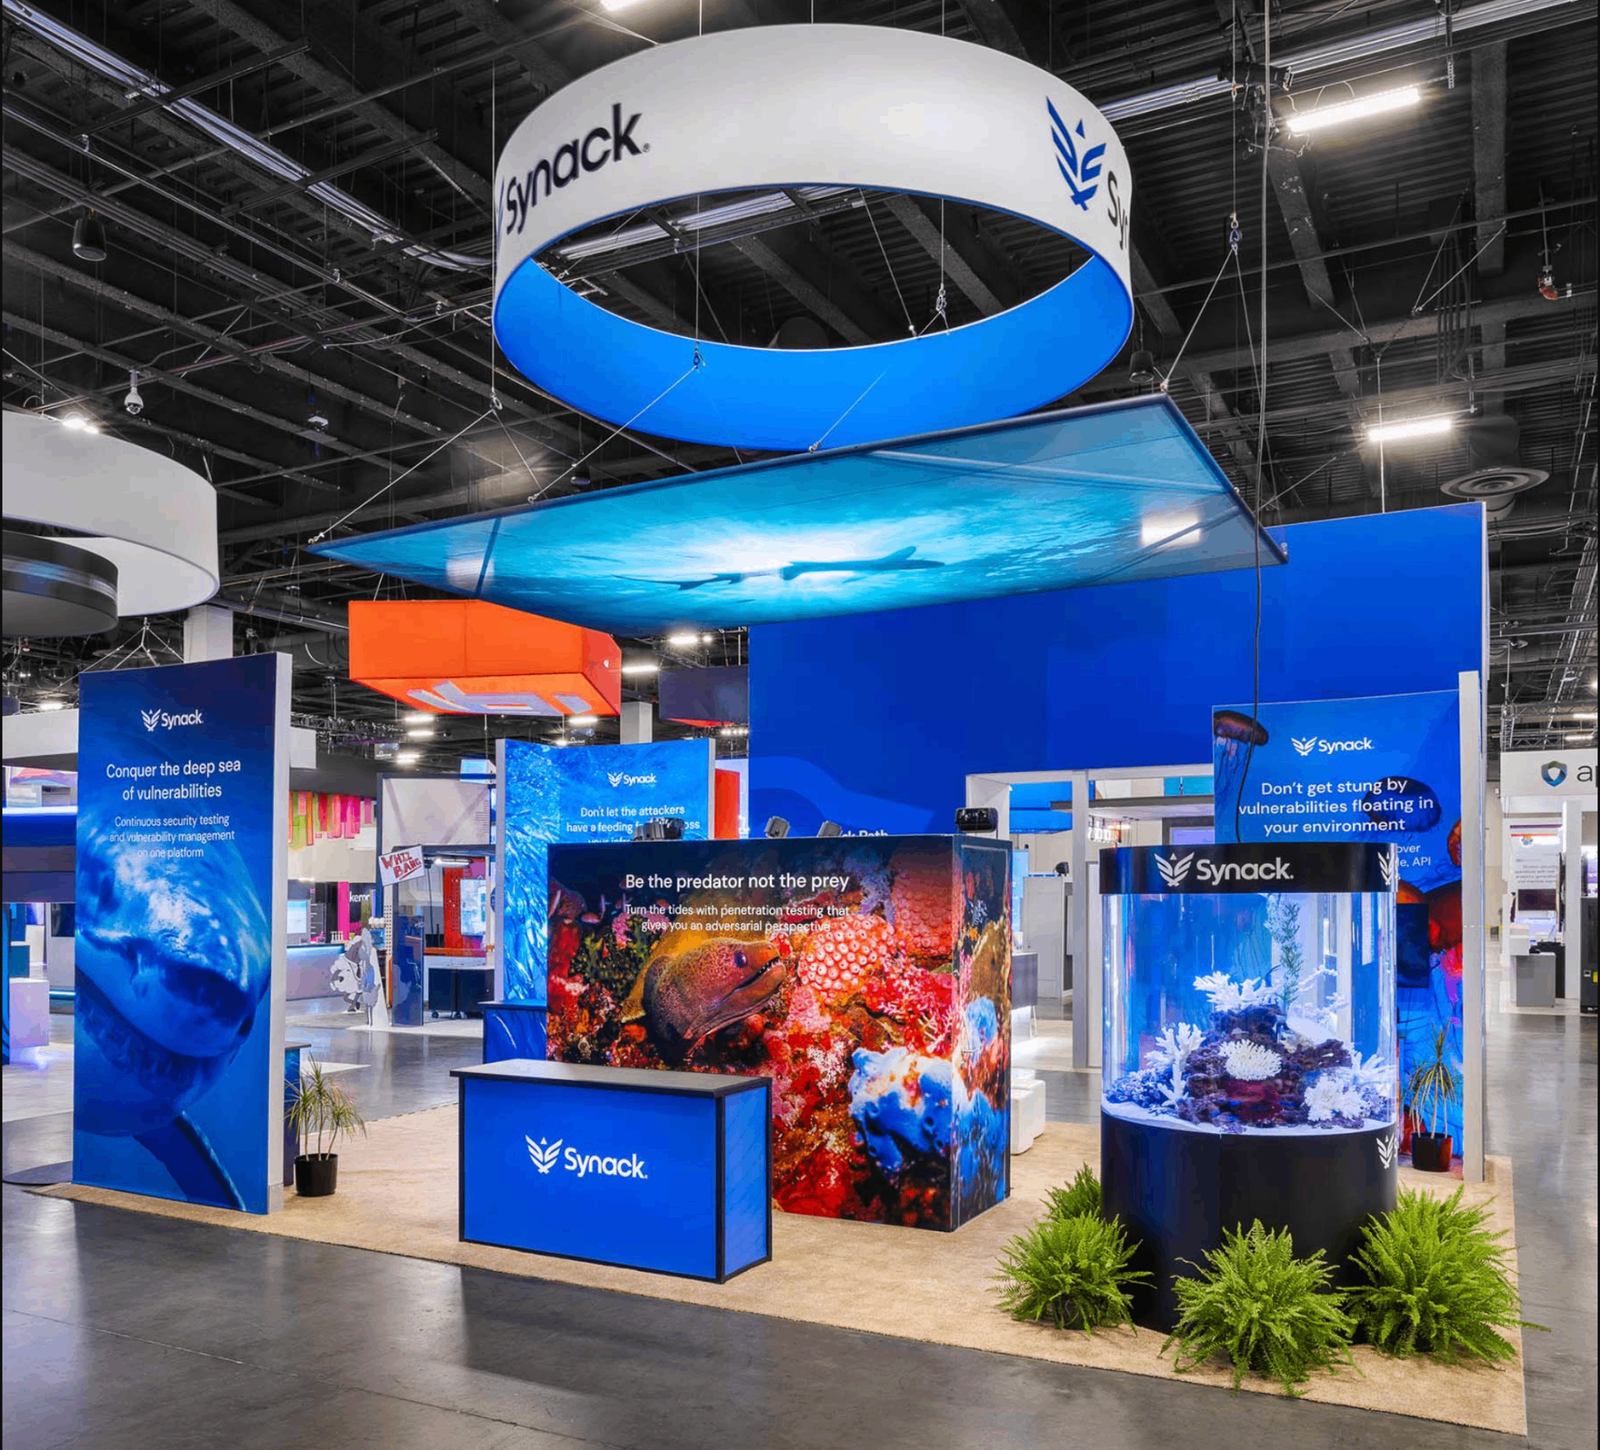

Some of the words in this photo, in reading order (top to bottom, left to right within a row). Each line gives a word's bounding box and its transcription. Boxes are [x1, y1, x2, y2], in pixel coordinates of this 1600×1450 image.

[106, 763, 157, 781] Conquer
[159, 761, 180, 776] the
[183, 759, 215, 778] deep
[218, 759, 241, 773] sea
[122, 786, 135, 800] of
[137, 782, 222, 800] vulnerabilities
[1307, 782, 1333, 797] get
[1337, 781, 1383, 795] stung
[1386, 777, 1408, 793] by
[606, 806, 618, 817] let
[621, 806, 636, 816] the
[638, 804, 685, 816] attackers
[1239, 801, 1348, 815] vulnerabilities
[1352, 798, 1414, 813] floating
[1419, 796, 1434, 809] in
[114, 815, 161, 827] Continuous
[163, 815, 198, 828] security
[199, 813, 230, 827] testing
[1264, 822, 1299, 837] your
[1302, 818, 1406, 834] environment
[566, 822, 588, 832] have
[590, 824, 596, 832] a
[597, 822, 633, 834] feeding
[109, 832, 125, 843] and
[126, 831, 176, 844] vulnerability
[178, 830, 235, 844] management
[150, 850, 166, 858] one
[167, 847, 204, 860] platform
[1412, 856, 1431, 867] API
[625, 874, 644, 888] Be
[648, 874, 672, 888] the
[676, 874, 744, 892] predator
[748, 874, 775, 888] not
[779, 873, 807, 888] the
[811, 875, 850, 892] prey
[625, 904, 648, 915] Turn
[649, 904, 666, 915] the
[668, 904, 693, 915] tides
[696, 904, 718, 915] with
[721, 904, 783, 918] penetration
[785, 904, 824, 918] testing
[826, 904, 850, 915] that
[641, 920, 667, 933] gives
[669, 922, 688, 933] you
[690, 922, 703, 931] an
[705, 920, 762, 931] adversarial
[765, 920, 831, 933] perspective
